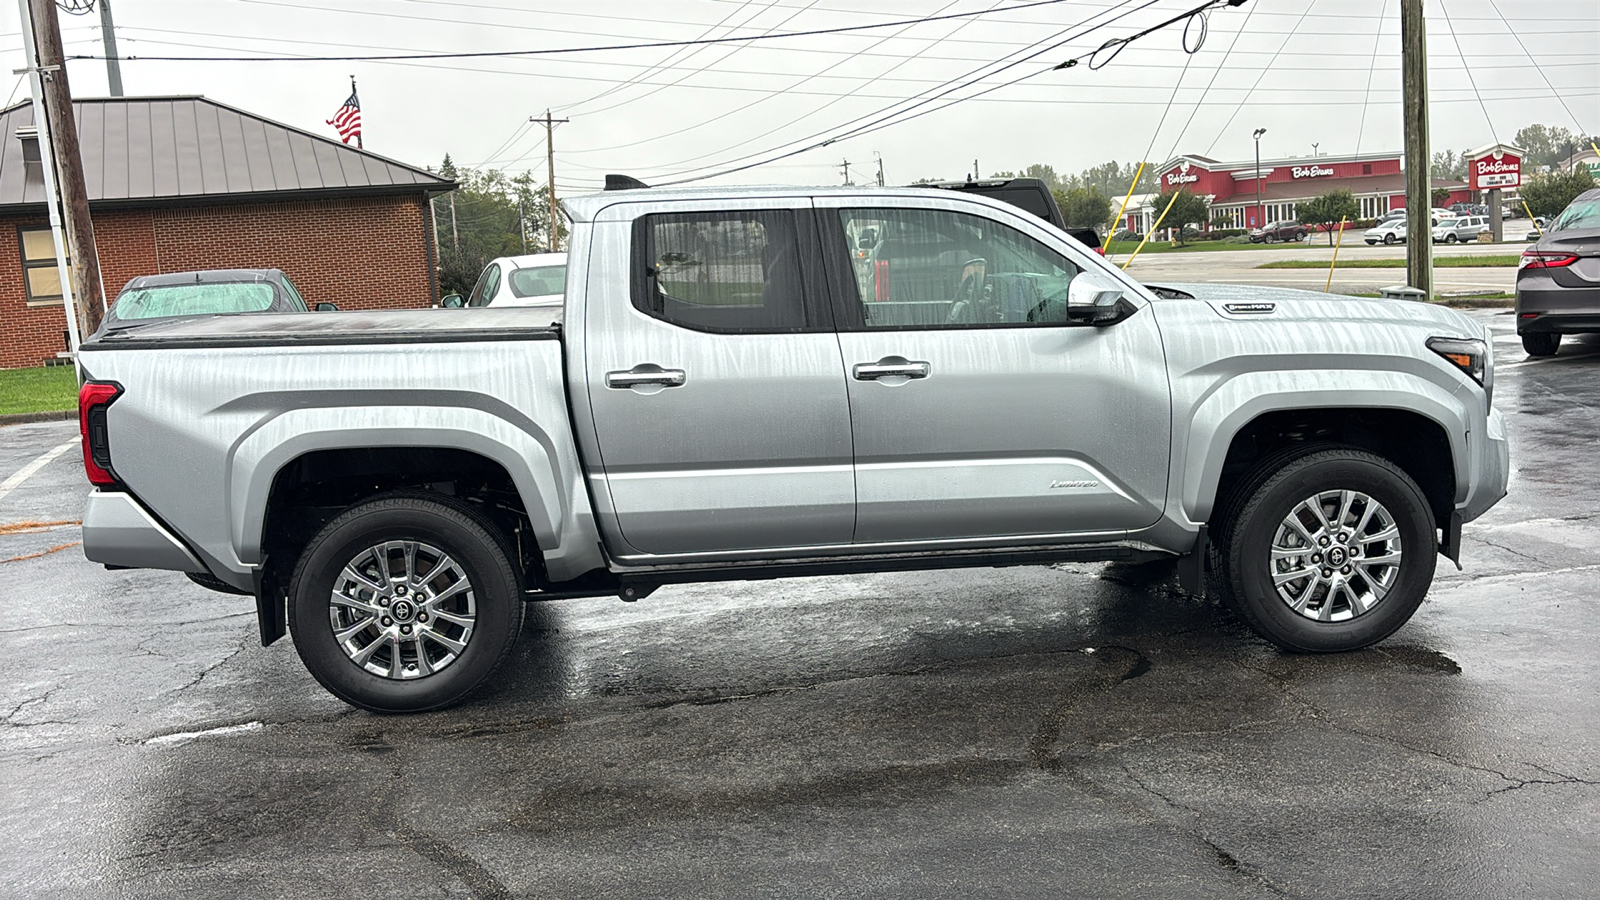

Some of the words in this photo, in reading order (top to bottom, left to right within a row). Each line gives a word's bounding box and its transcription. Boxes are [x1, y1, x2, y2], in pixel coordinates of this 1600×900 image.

[1292, 166, 1310, 178] Bob
[1310, 165, 1334, 178] Evans
[1477, 161, 1494, 174] Bob
[1494, 160, 1519, 173] Evans
[1167, 174, 1180, 184] Bob
